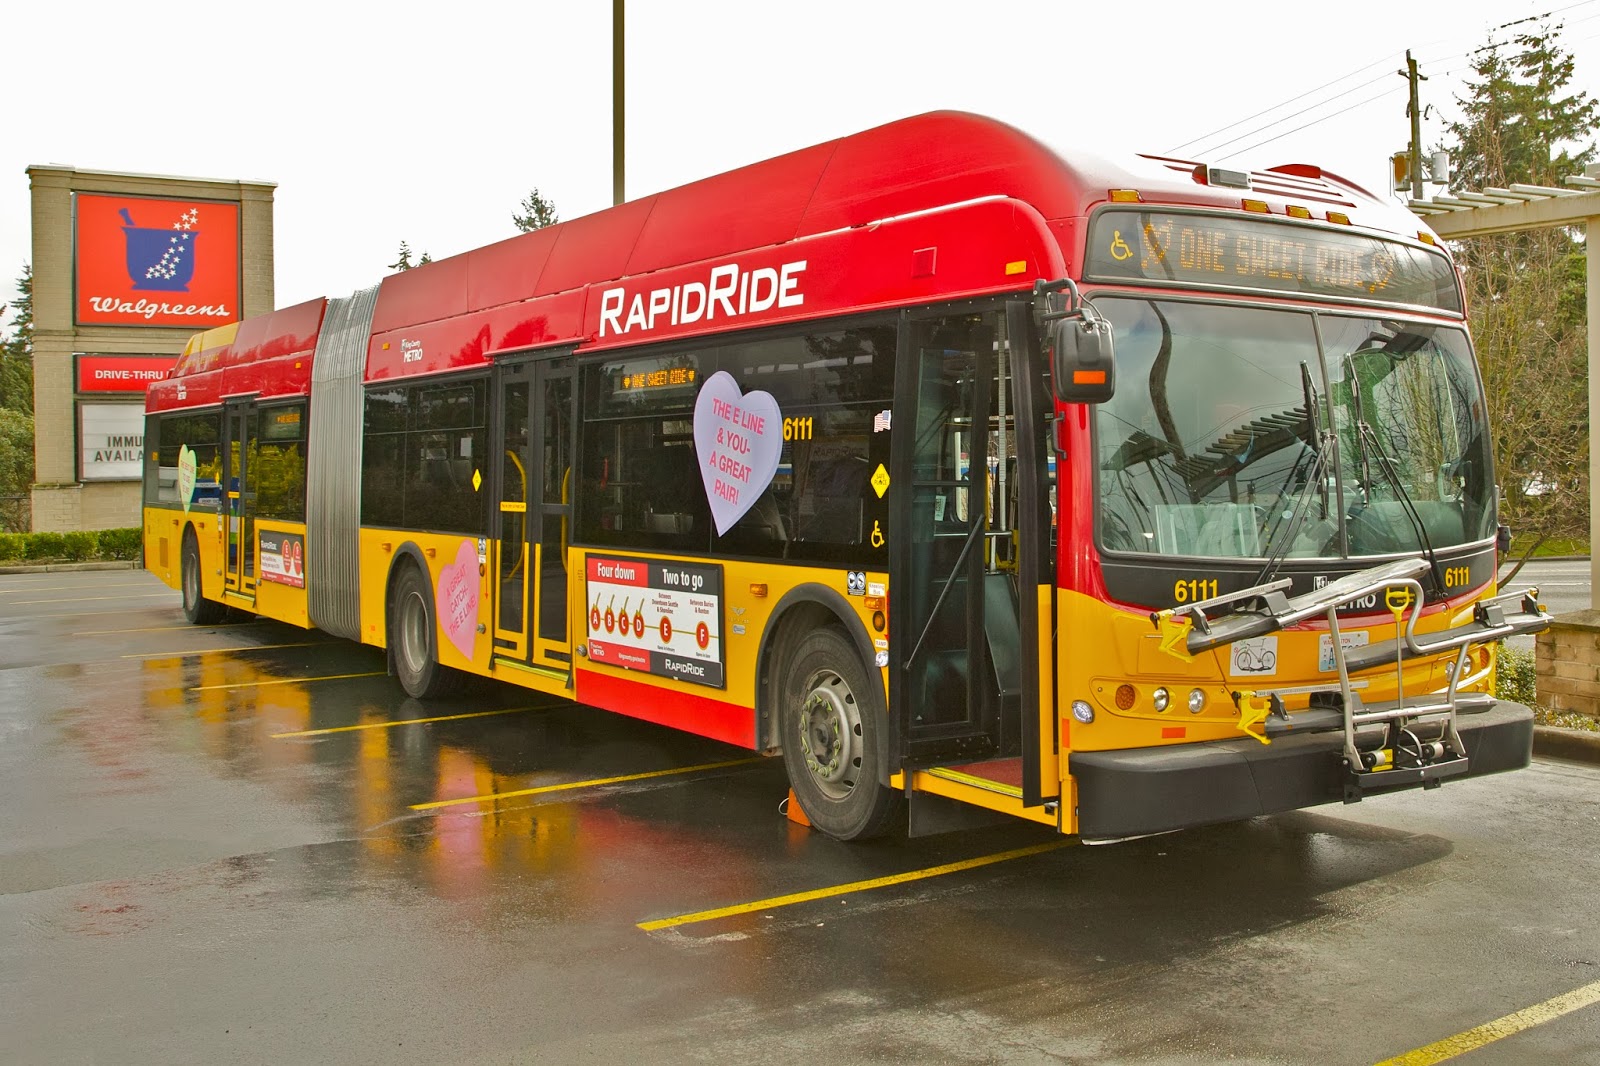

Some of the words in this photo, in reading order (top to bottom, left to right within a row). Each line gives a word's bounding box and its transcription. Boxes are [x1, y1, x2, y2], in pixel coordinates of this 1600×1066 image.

[1180, 227, 1226, 273] ONE
[1236, 234, 1306, 279] SWEET
[1315, 245, 1364, 287] RIDE
[89, 297, 230, 318] Walgreens
[403, 348, 422, 362] METRO
[95, 370, 164, 380] DRIVE-THRU
[632, 373, 645, 388] ONE
[647, 370, 668, 386] SWEET
[669, 368, 687, 384] RIDE
[713, 398, 732, 421] THE
[733, 407, 741, 424] E
[742, 410, 765, 435] LINE
[783, 416, 812, 440] 6111
[108, 436, 142, 448] IMMU
[717, 428, 723, 444] &
[727, 430, 751, 455] YOU-
[709, 450, 717, 468] A
[719, 455, 752, 484] GREAT
[714, 479, 739, 506] PAIR!
[598, 562, 613, 578] Four
[614, 564, 635, 580] down
[662, 568, 679, 585] Two
[680, 571, 690, 586] to
[692, 574, 703, 591] go
[1445, 567, 1470, 588] 6111
[1174, 579, 1218, 602] 6111
[593, 612, 598, 624] A
[608, 614, 612, 627] B
[622, 617, 626, 630] C
[636, 618, 642, 632] D
[664, 624, 669, 636] E
[700, 629, 706, 642] F
